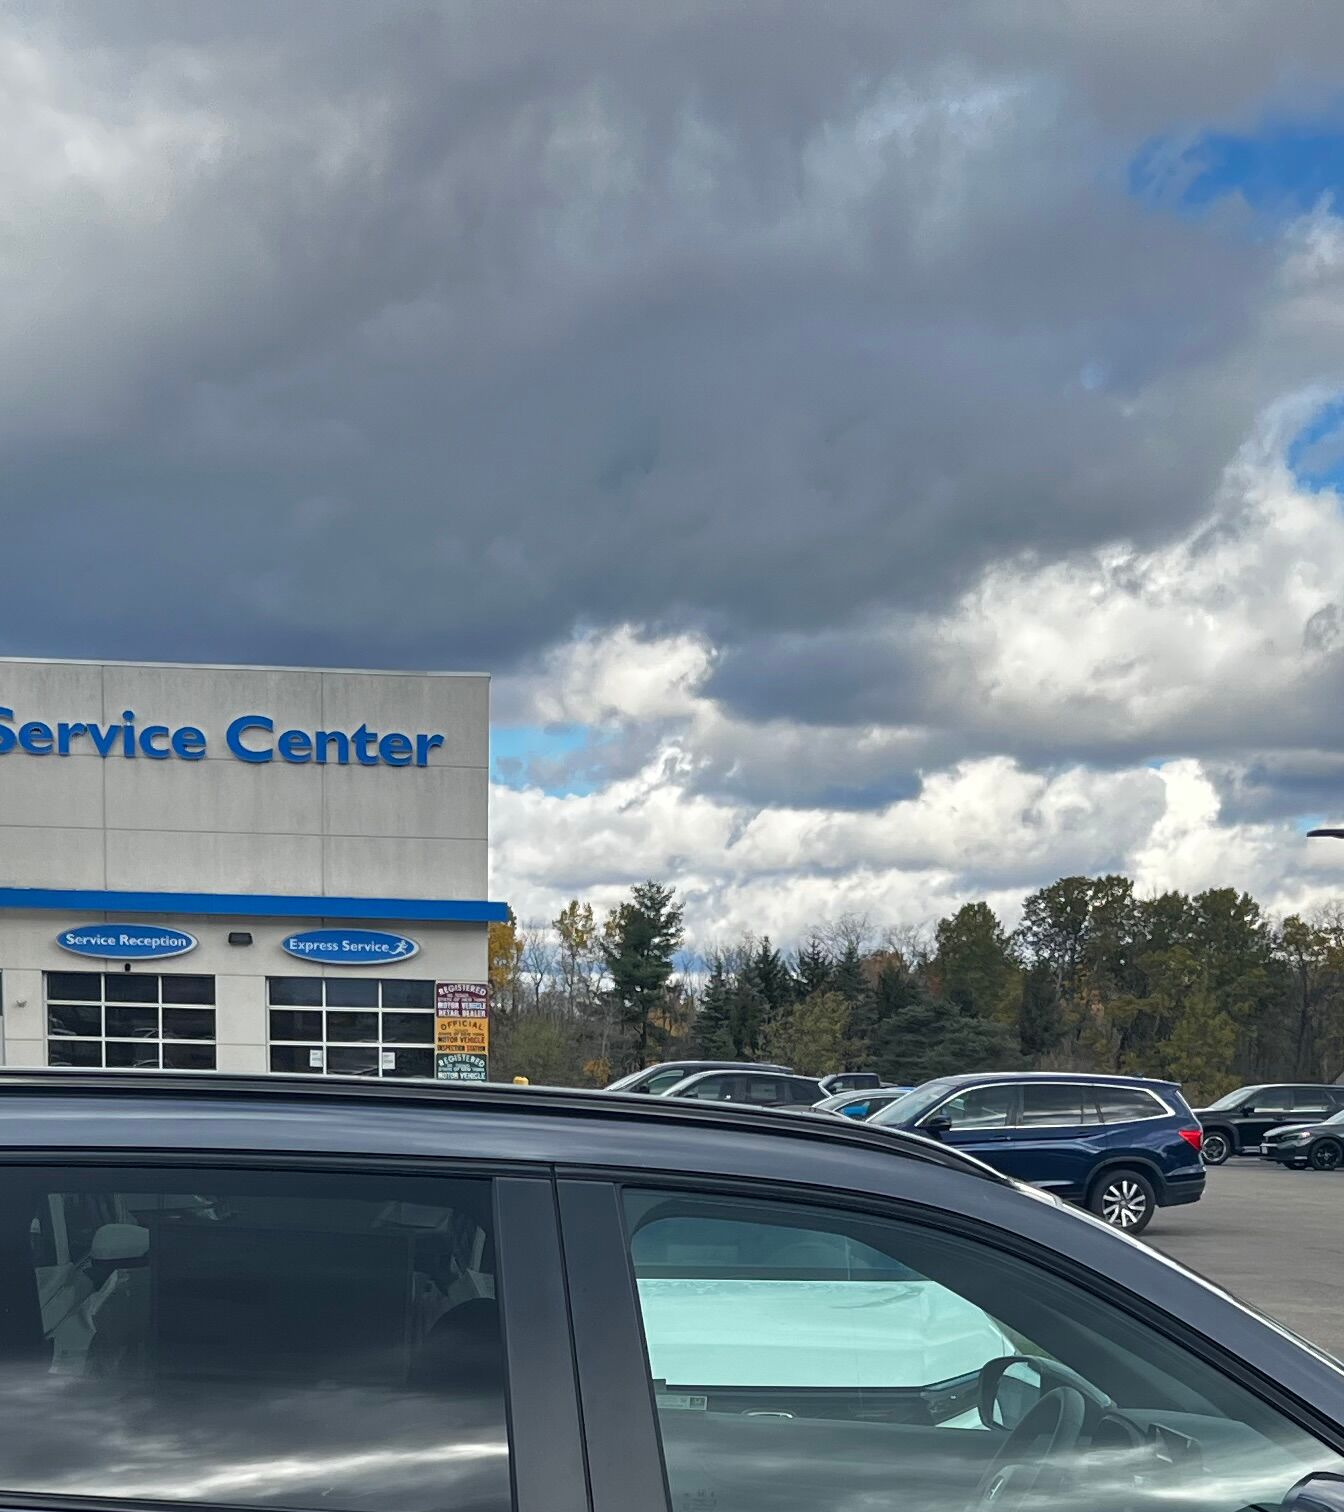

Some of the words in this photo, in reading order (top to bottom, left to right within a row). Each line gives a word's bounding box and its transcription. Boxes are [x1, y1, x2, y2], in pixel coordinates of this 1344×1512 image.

[226, 715, 445, 767] Center
[65, 933, 116, 946] Service
[119, 934, 187, 948] Reception
[289, 939, 338, 952] Express
[342, 940, 390, 953] Service
[438, 984, 486, 996] REGISTERED
[440, 1020, 484, 1031] OFFICIAL
[438, 1054, 485, 1067] REGISTERED
